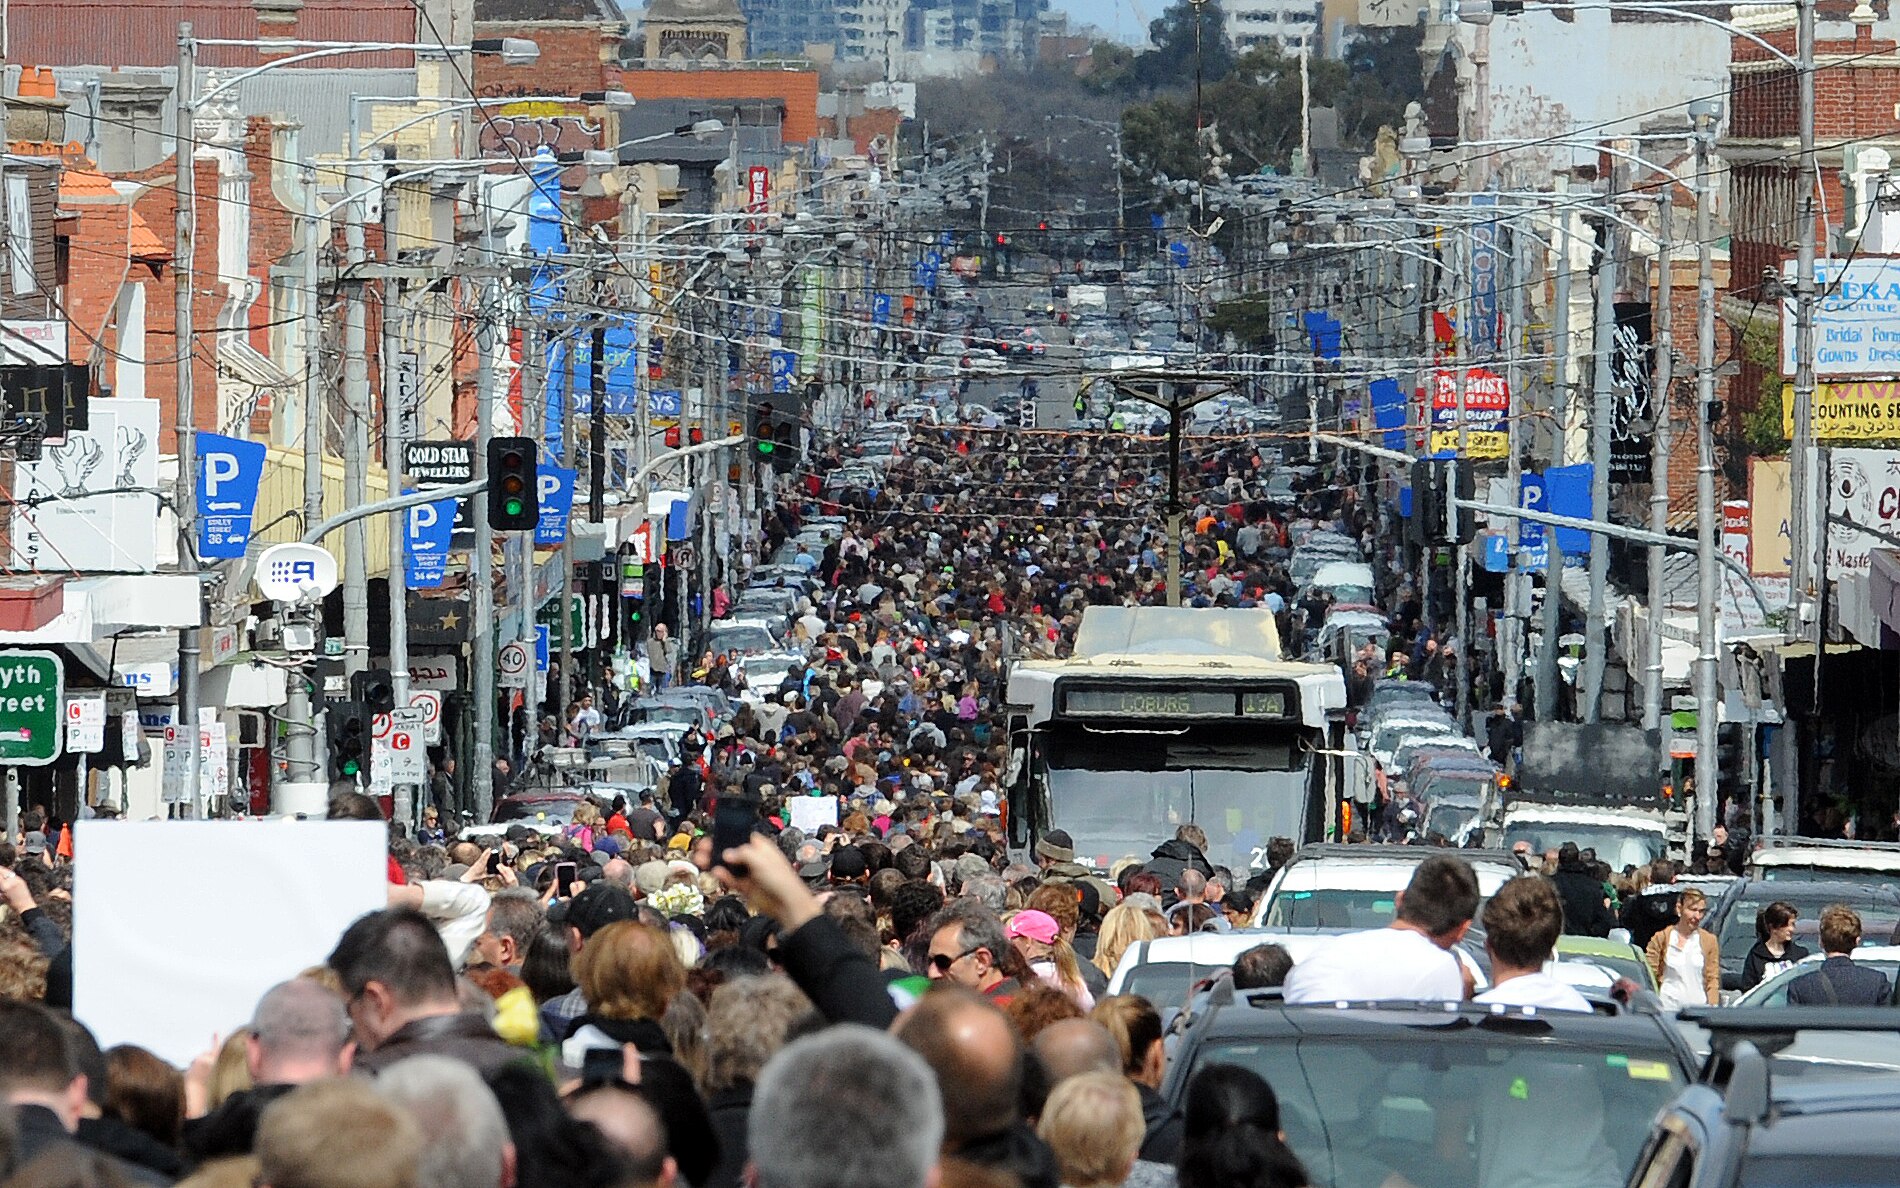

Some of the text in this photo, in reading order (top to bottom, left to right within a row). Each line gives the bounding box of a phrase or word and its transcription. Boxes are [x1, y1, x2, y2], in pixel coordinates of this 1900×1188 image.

[1825, 302, 1897, 313] COUTURE
[1826, 326, 1863, 343] Bridal
[1817, 347, 1859, 364] Gowns
[572, 394, 613, 409] OPN
[1791, 403, 1882, 419] OUNTING
[440, 447, 470, 464] STAR
[205, 452, 240, 497] P
[408, 466, 471, 478] JEWELLERS
[537, 475, 561, 503] P
[1522, 485, 1542, 510] P
[1878, 486, 1900, 520] C
[410, 503, 438, 538] P
[1836, 549, 1870, 568] Maste
[503, 651, 522, 666] 40
[0, 664, 40, 689] yth
